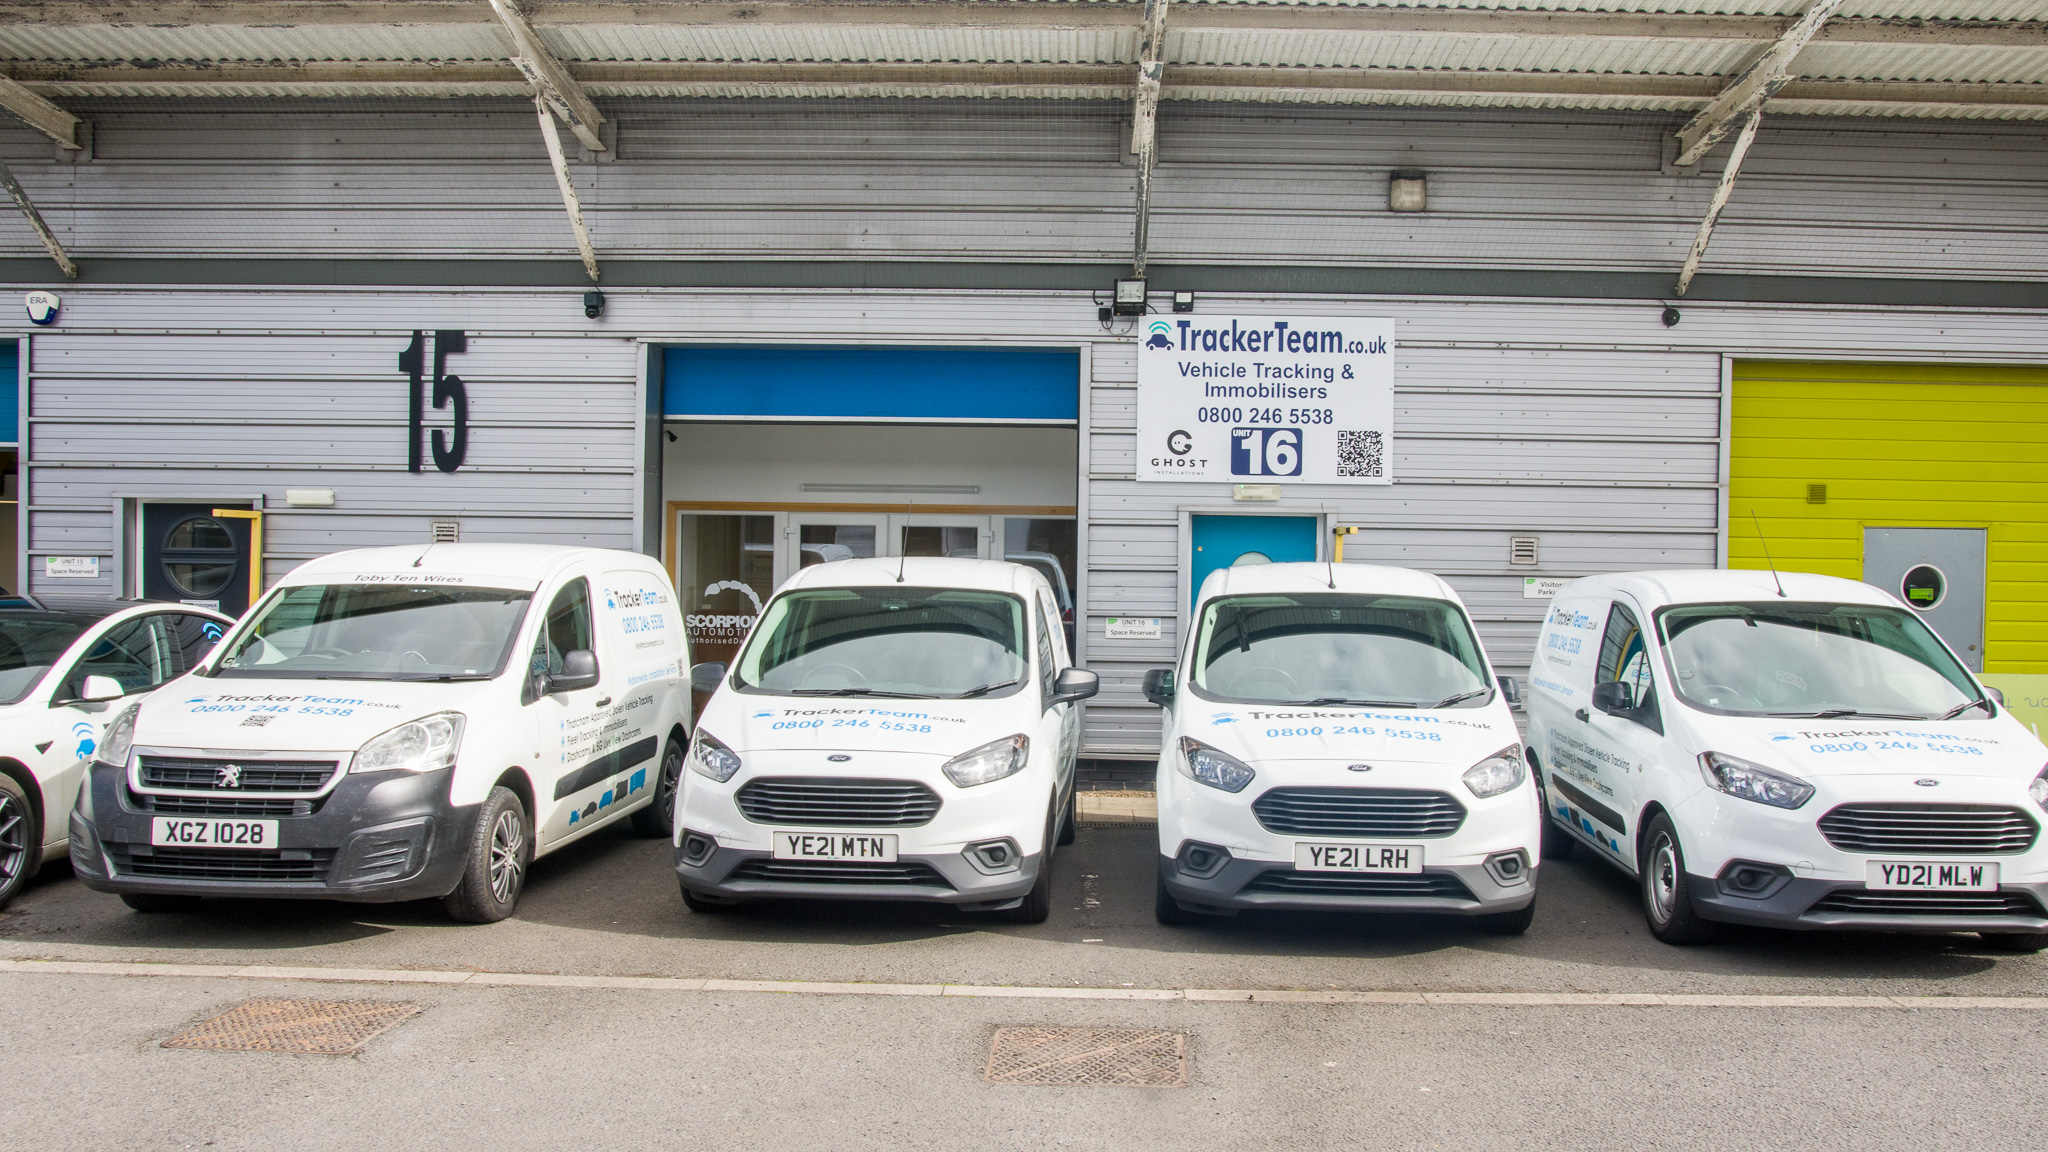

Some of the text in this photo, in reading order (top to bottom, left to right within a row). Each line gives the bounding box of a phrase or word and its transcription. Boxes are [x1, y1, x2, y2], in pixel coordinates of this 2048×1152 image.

[30, 296, 48, 304] ERA
[1177, 319, 1387, 355] TrackerTeam.co.uk
[1178, 362, 1355, 383] Vehicle Tracking &
[1205, 382, 1328, 399] Immobilisers
[398, 330, 467, 474] 15
[1198, 407, 1333, 425] 0800 246 5538
[1233, 429, 1251, 437] UNIT
[1241, 430, 1298, 476] 16
[1151, 458, 1208, 468] GHOST
[354, 574, 464, 583] Toby Ten Wires
[614, 589, 668, 608] TrackerTeam.co.uk
[622, 613, 664, 634] 0800 246 5538
[216, 694, 402, 709] TrackerTeam.co.uk
[625, 700, 639, 711] Vehicle
[639, 694, 654, 707] Tracking
[191, 704, 354, 717] 0800 246 5538
[784, 708, 967, 724] TrackerTeam.co.uk
[772, 719, 932, 734] 0800 246 5538
[1247, 711, 1492, 731] TrackerTeam.co.uk
[1266, 726, 1442, 742] 0800 246 5538
[1797, 730, 2002, 746] TrackerTeam.co.uk
[1809, 741, 1983, 756] 0800 246 5538
[166, 821, 263, 844] XGZ 1028
[788, 835, 884, 857] YE21 MTN
[1310, 847, 1409, 868] YE21 LRH
[1881, 864, 1983, 886] YD21 MLW
